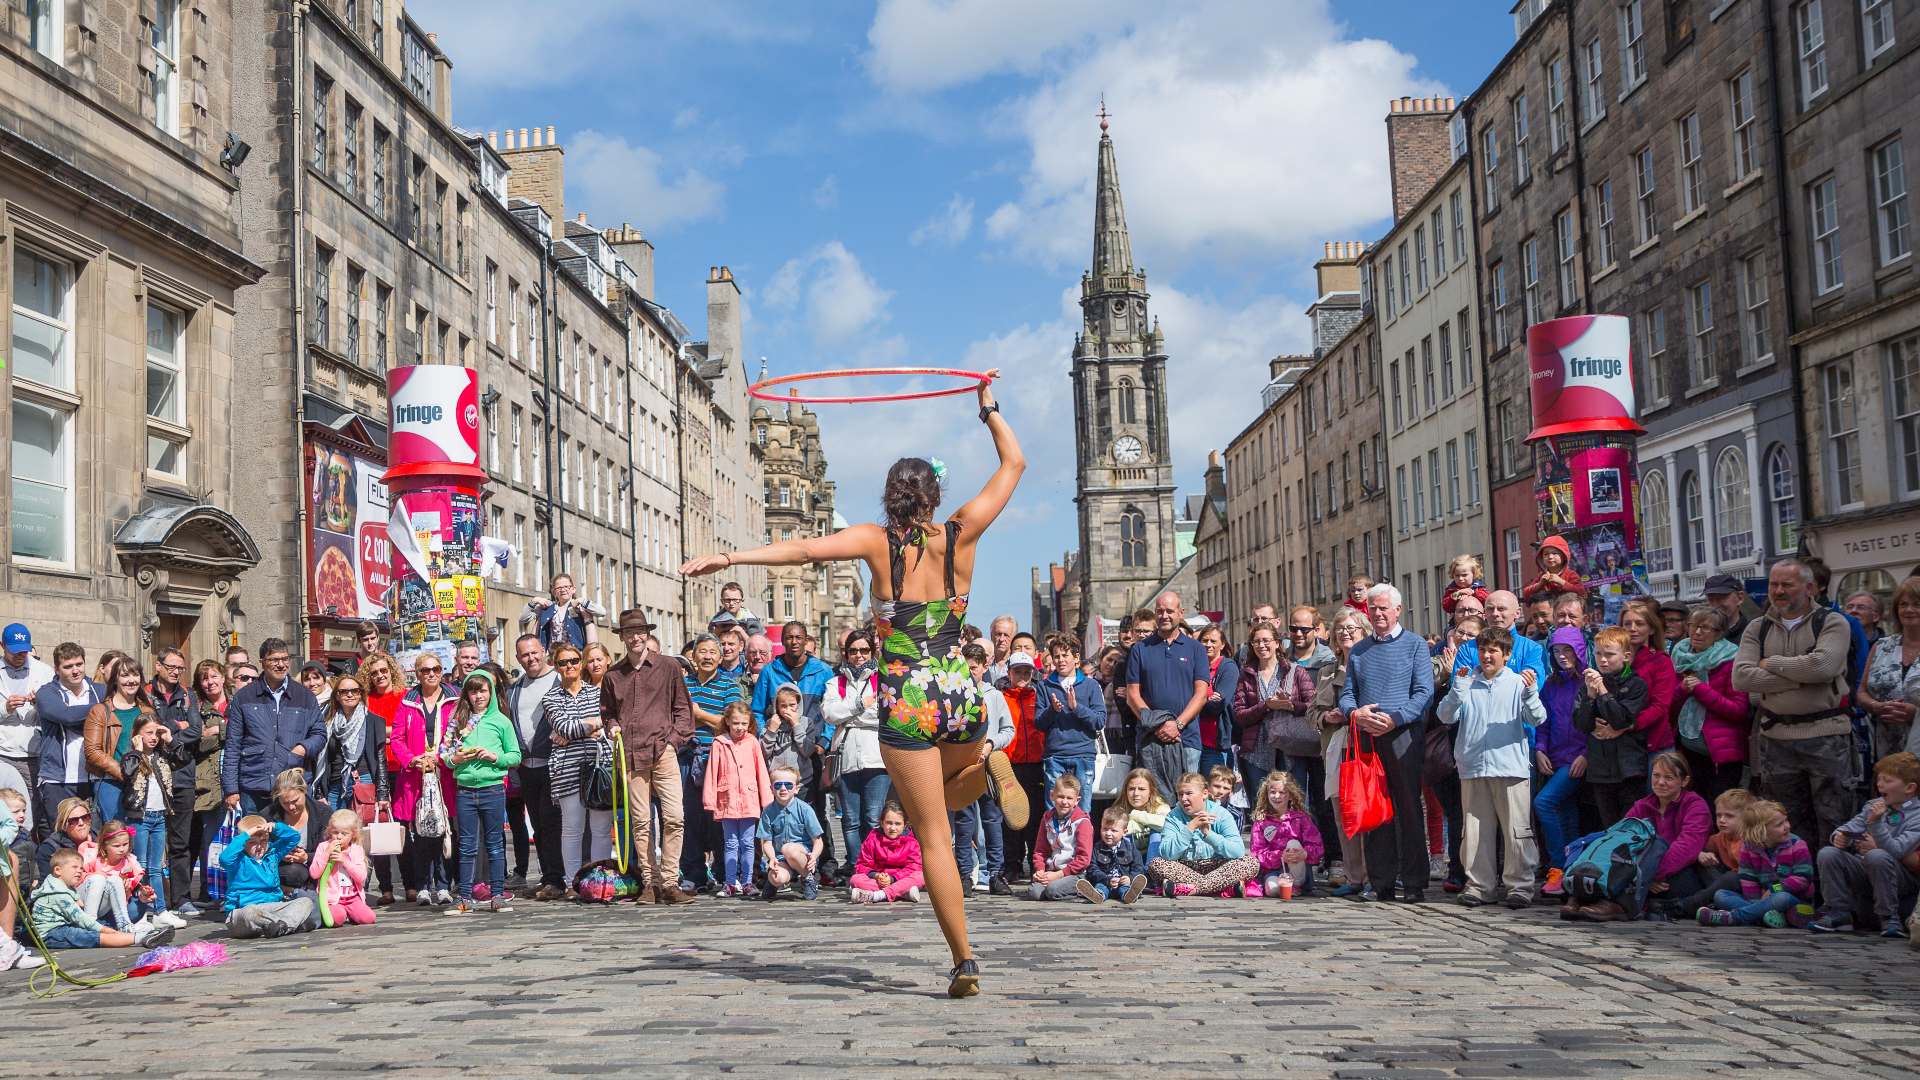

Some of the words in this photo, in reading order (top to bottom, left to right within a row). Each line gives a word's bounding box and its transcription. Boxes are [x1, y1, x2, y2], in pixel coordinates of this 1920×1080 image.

[1570, 357, 1622, 379] fringe
[396, 404, 443, 425] fringe
[364, 535, 372, 562] 2
[1843, 537, 1887, 554] TASTE
[1891, 533, 1909, 548] OF
[14, 633, 27, 641] NY
